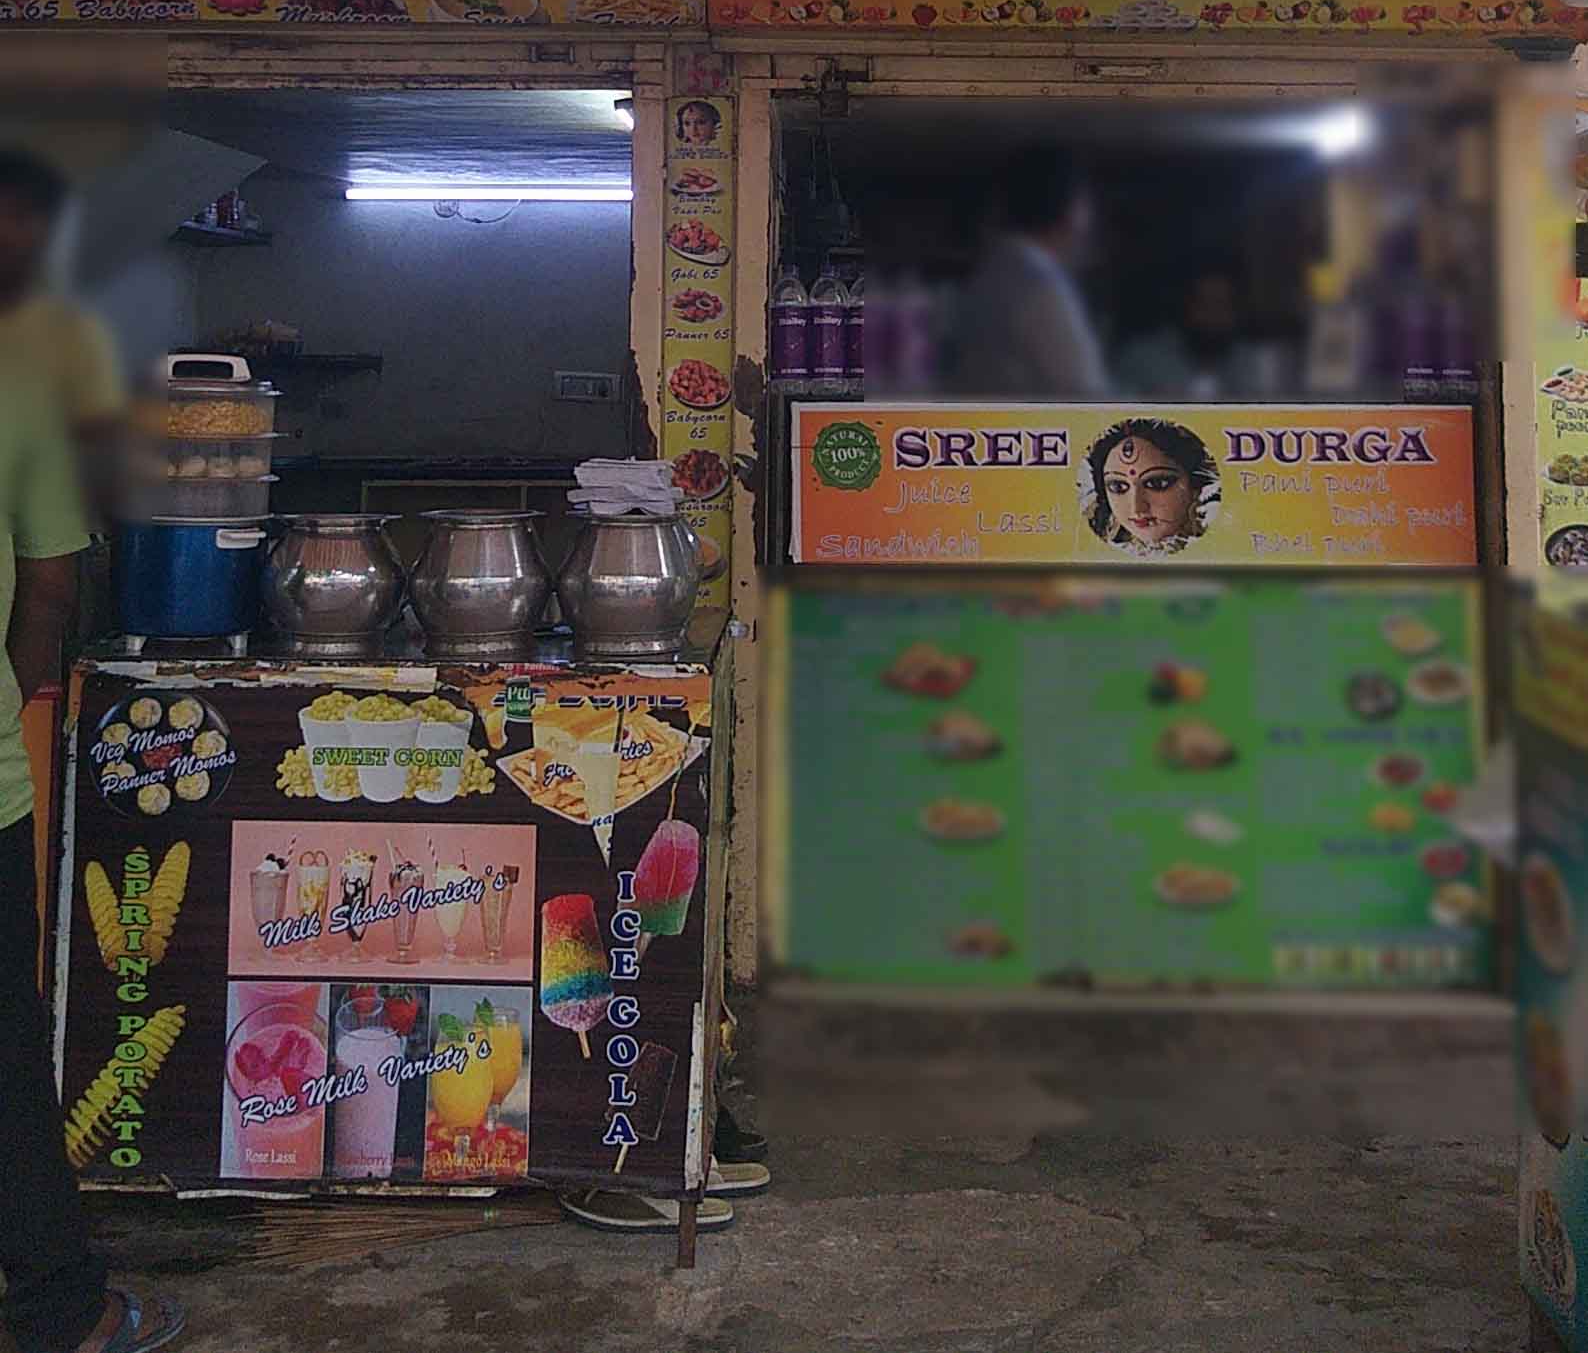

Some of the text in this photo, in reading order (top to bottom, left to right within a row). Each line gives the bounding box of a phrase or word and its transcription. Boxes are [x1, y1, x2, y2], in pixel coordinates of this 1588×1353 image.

[713, 327, 732, 340] 65
[690, 427, 709, 439] 65
[895, 426, 1438, 469] SREE DURGA
[976, 504, 1063, 533] Lassi
[815, 528, 981, 559] Sandwich
[90, 726, 197, 764] Veg Momos
[312, 746, 464, 768] SWEET CORN
[99, 748, 238, 796] Panner Momos
[259, 911, 322, 948] Milk
[329, 893, 401, 935] Shake
[109, 852, 151, 1169] SPRING POTATO
[602, 870, 642, 1146] ICE GOLA
[240, 1093, 299, 1128] Rose
[300, 1065, 368, 1107] Milk
[245, 1147, 297, 1164] Rose Lassi
